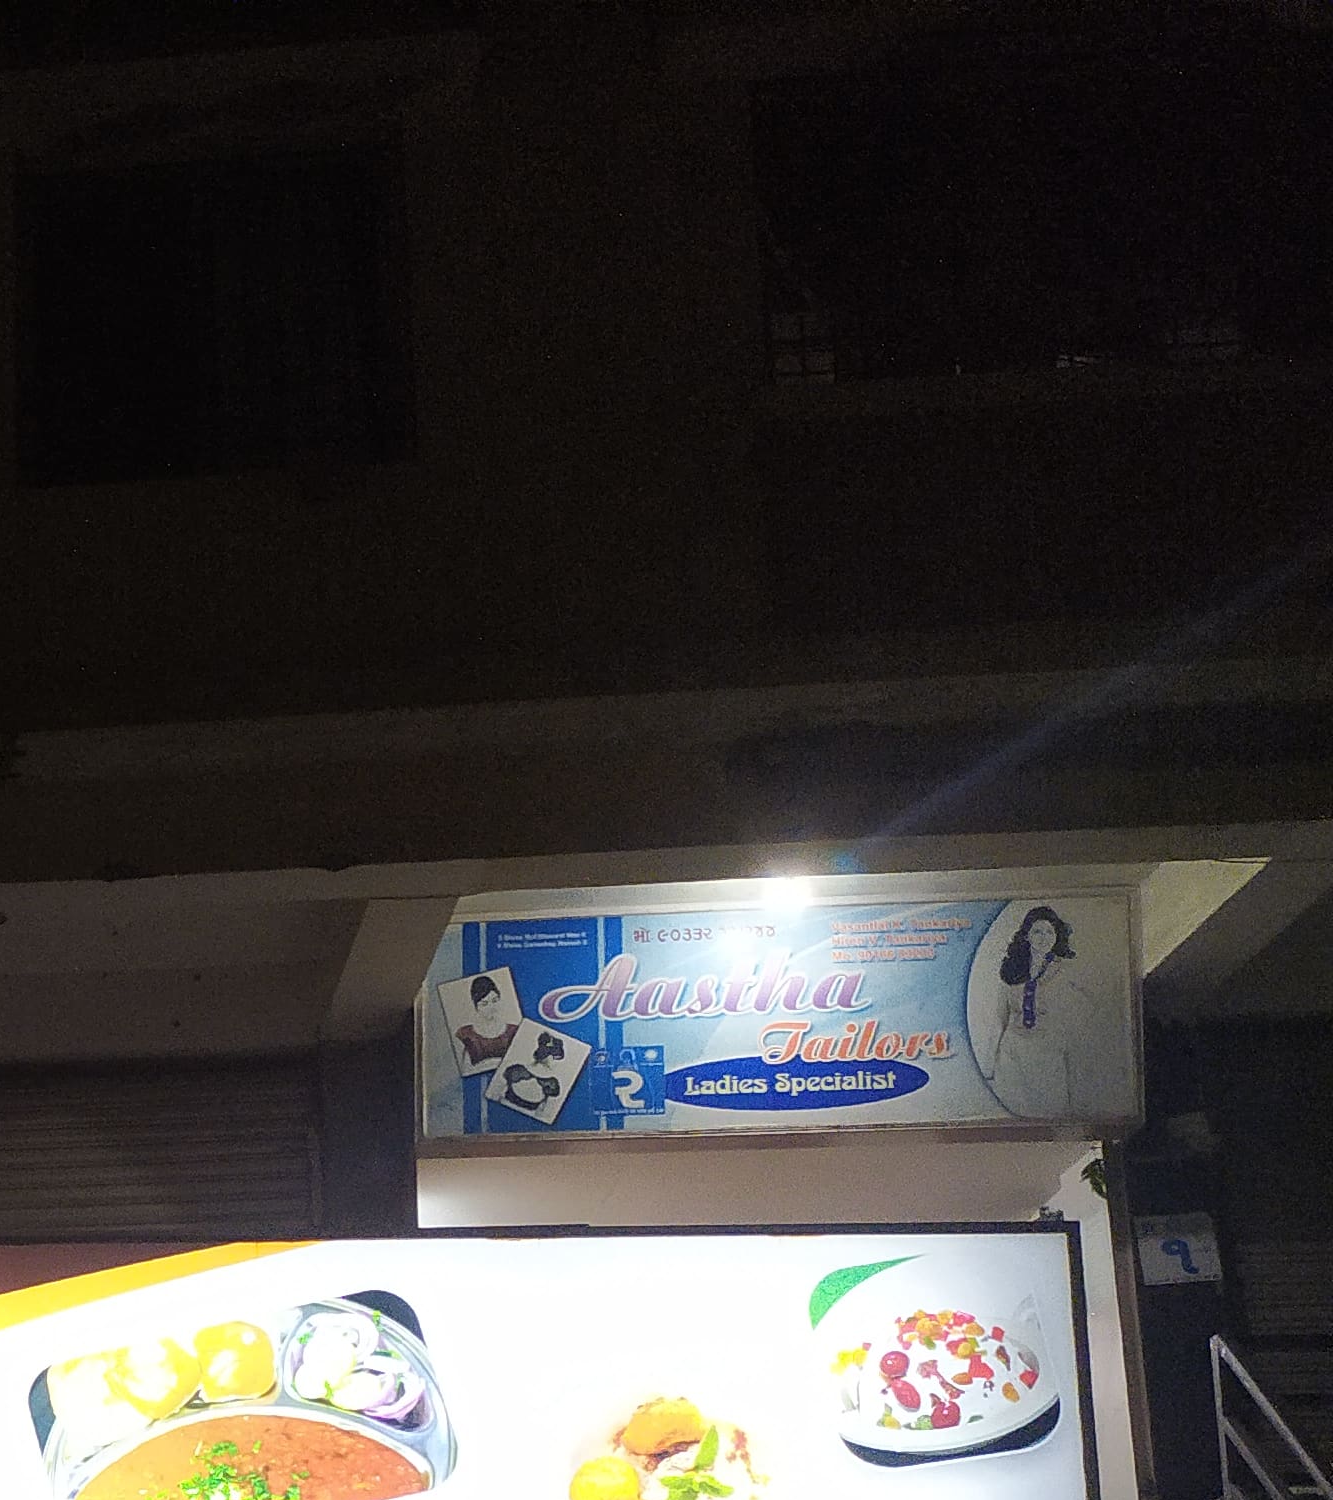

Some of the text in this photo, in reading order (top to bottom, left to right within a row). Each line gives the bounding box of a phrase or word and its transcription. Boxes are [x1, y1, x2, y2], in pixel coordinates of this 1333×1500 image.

[538, 950, 871, 1023] Aastha
[758, 1020, 950, 1066] Tailors
[684, 1069, 897, 1098] Ladies Specialist
